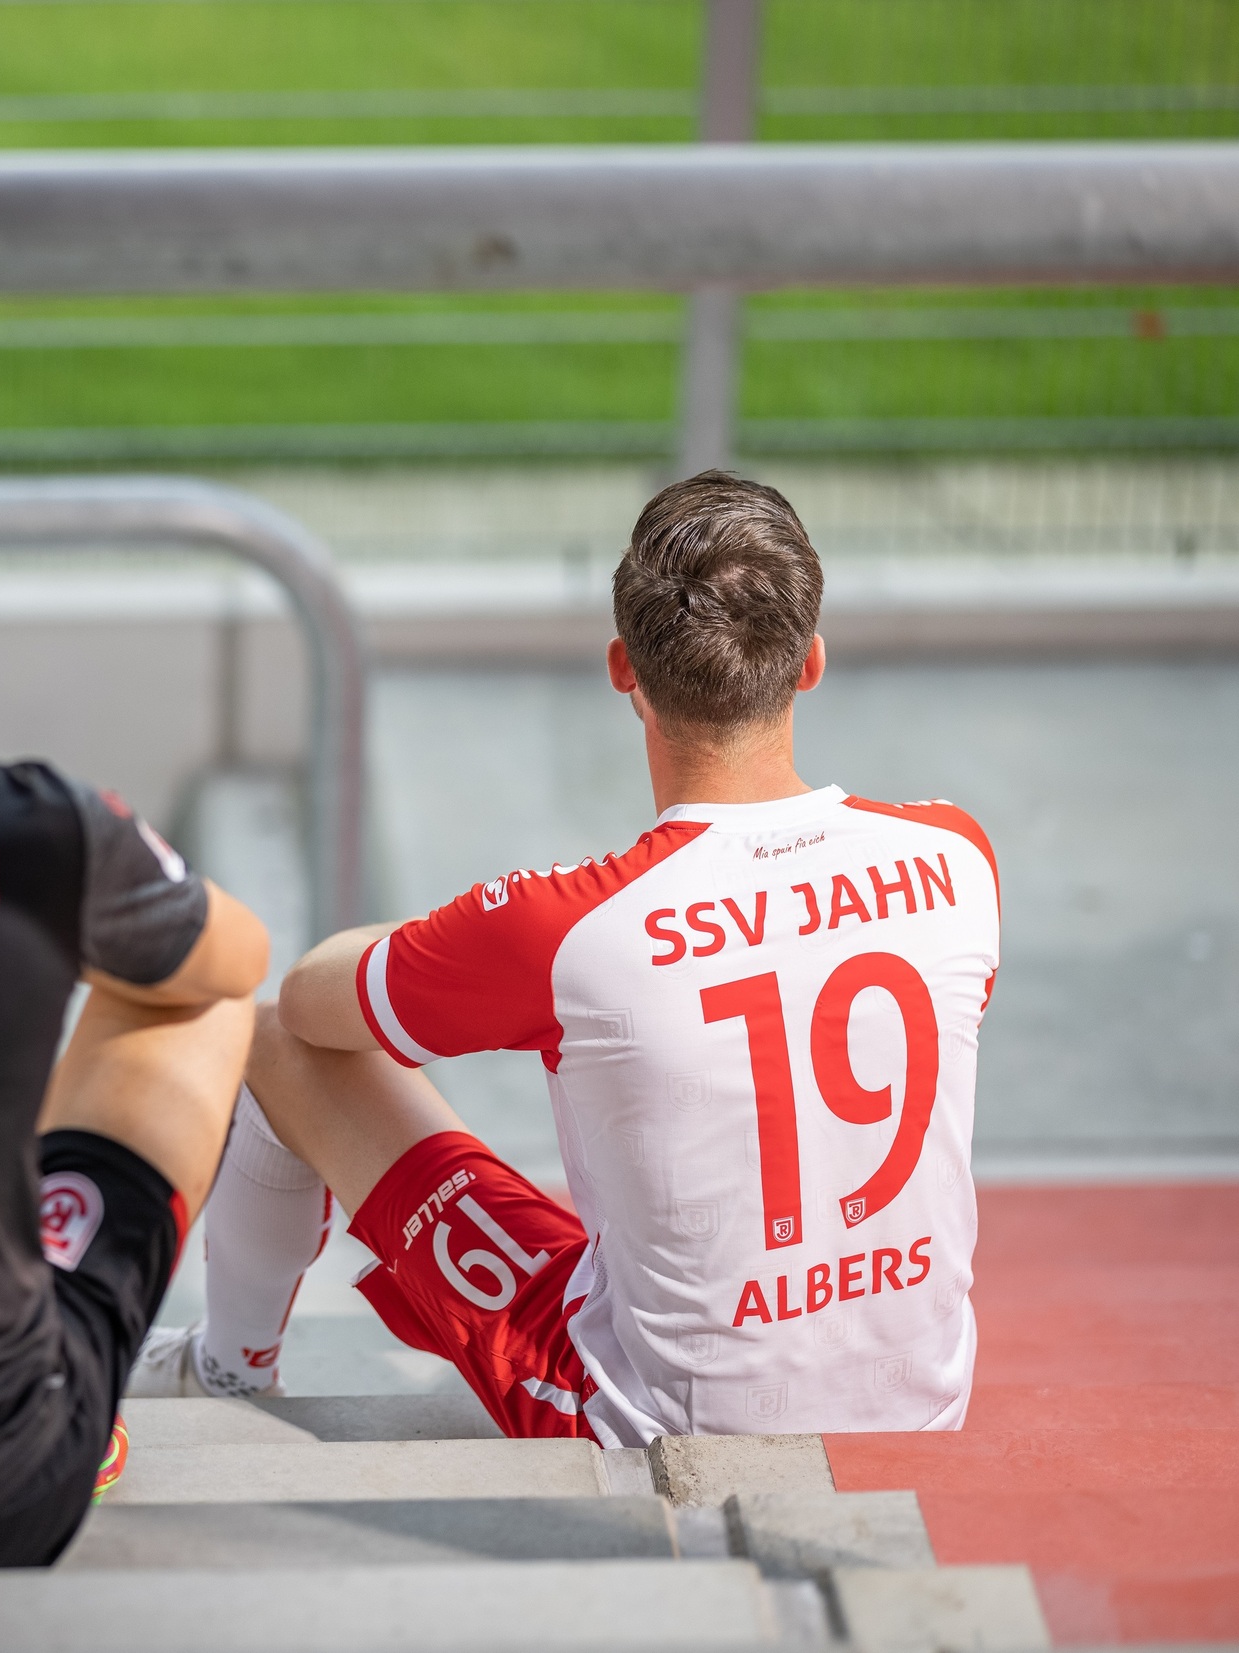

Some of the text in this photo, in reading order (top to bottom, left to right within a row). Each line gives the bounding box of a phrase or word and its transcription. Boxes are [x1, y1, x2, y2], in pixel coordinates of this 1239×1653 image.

[752, 846, 769, 862] Mia
[808, 830, 826, 846] eich
[644, 853, 957, 967] SSV JAHN
[700, 951, 940, 1251] 19
[433, 1193, 552, 1311] 19
[732, 1236, 933, 1328] ALBERS
